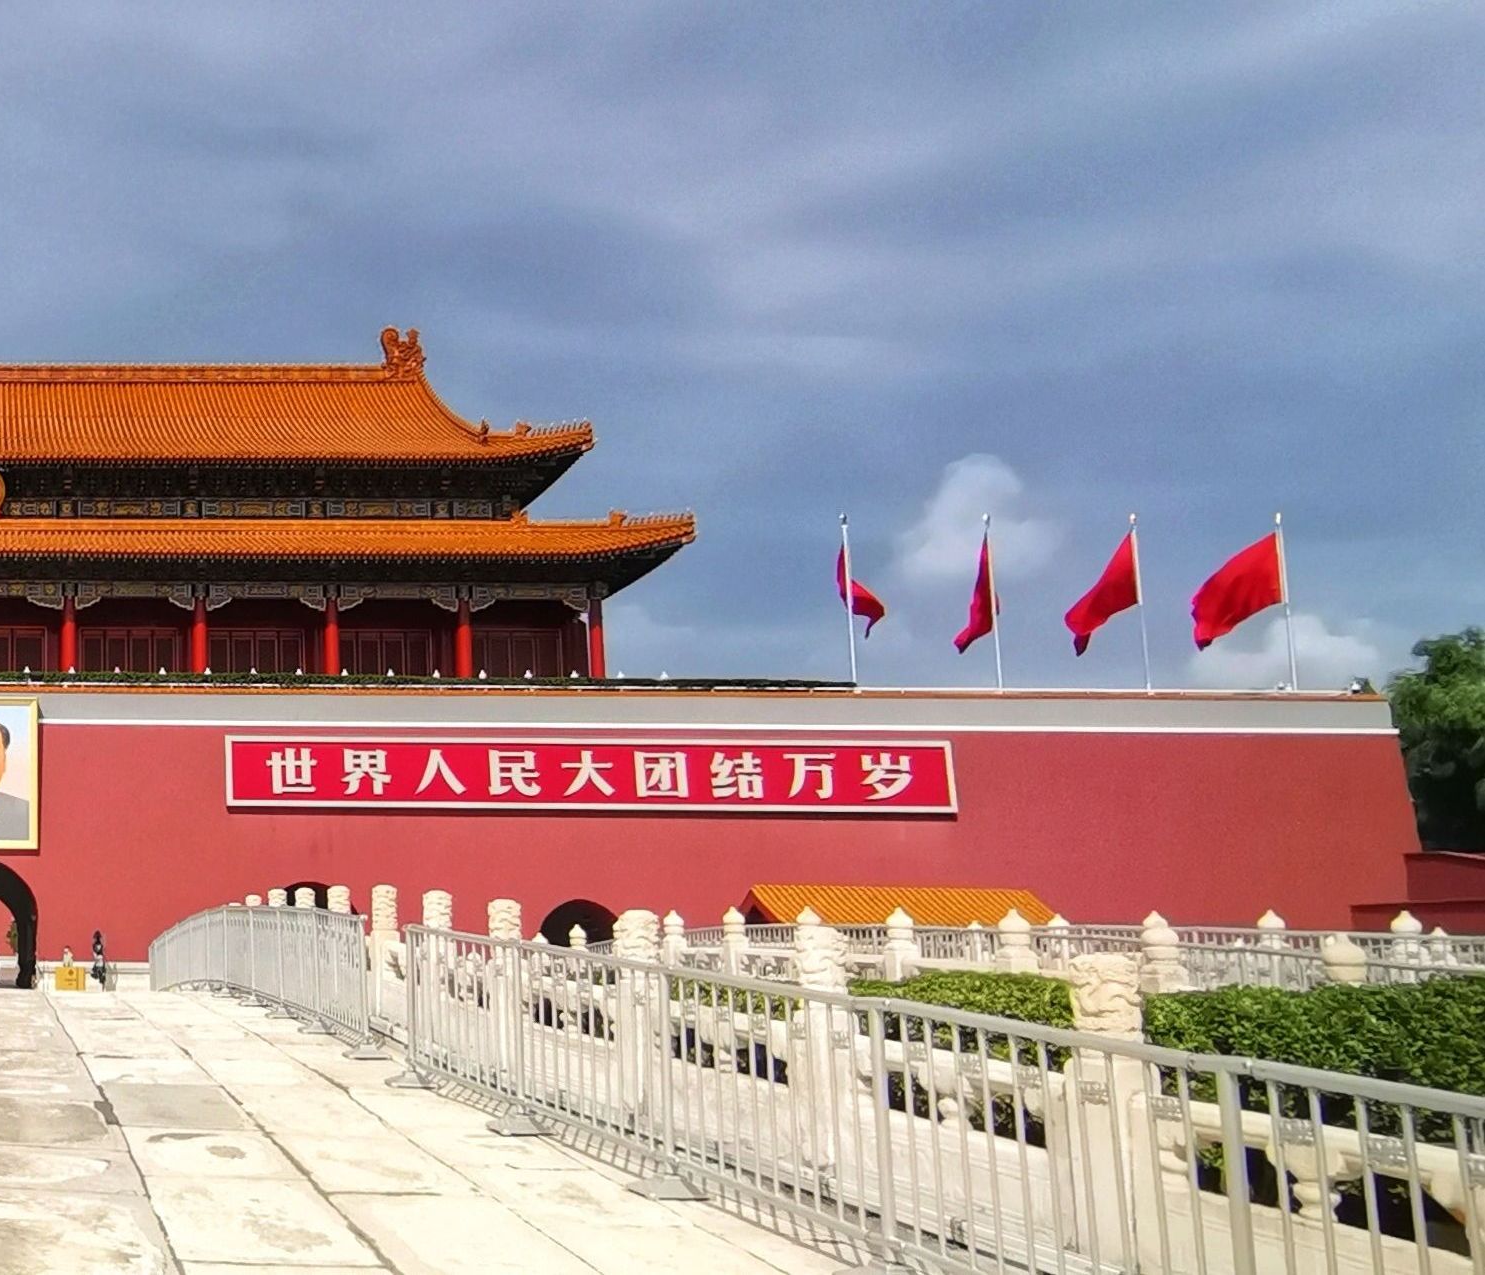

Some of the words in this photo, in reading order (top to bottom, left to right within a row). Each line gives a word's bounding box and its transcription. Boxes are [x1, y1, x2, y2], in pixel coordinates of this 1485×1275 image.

[266, 747, 913, 800] 世界人民大团结万岁
